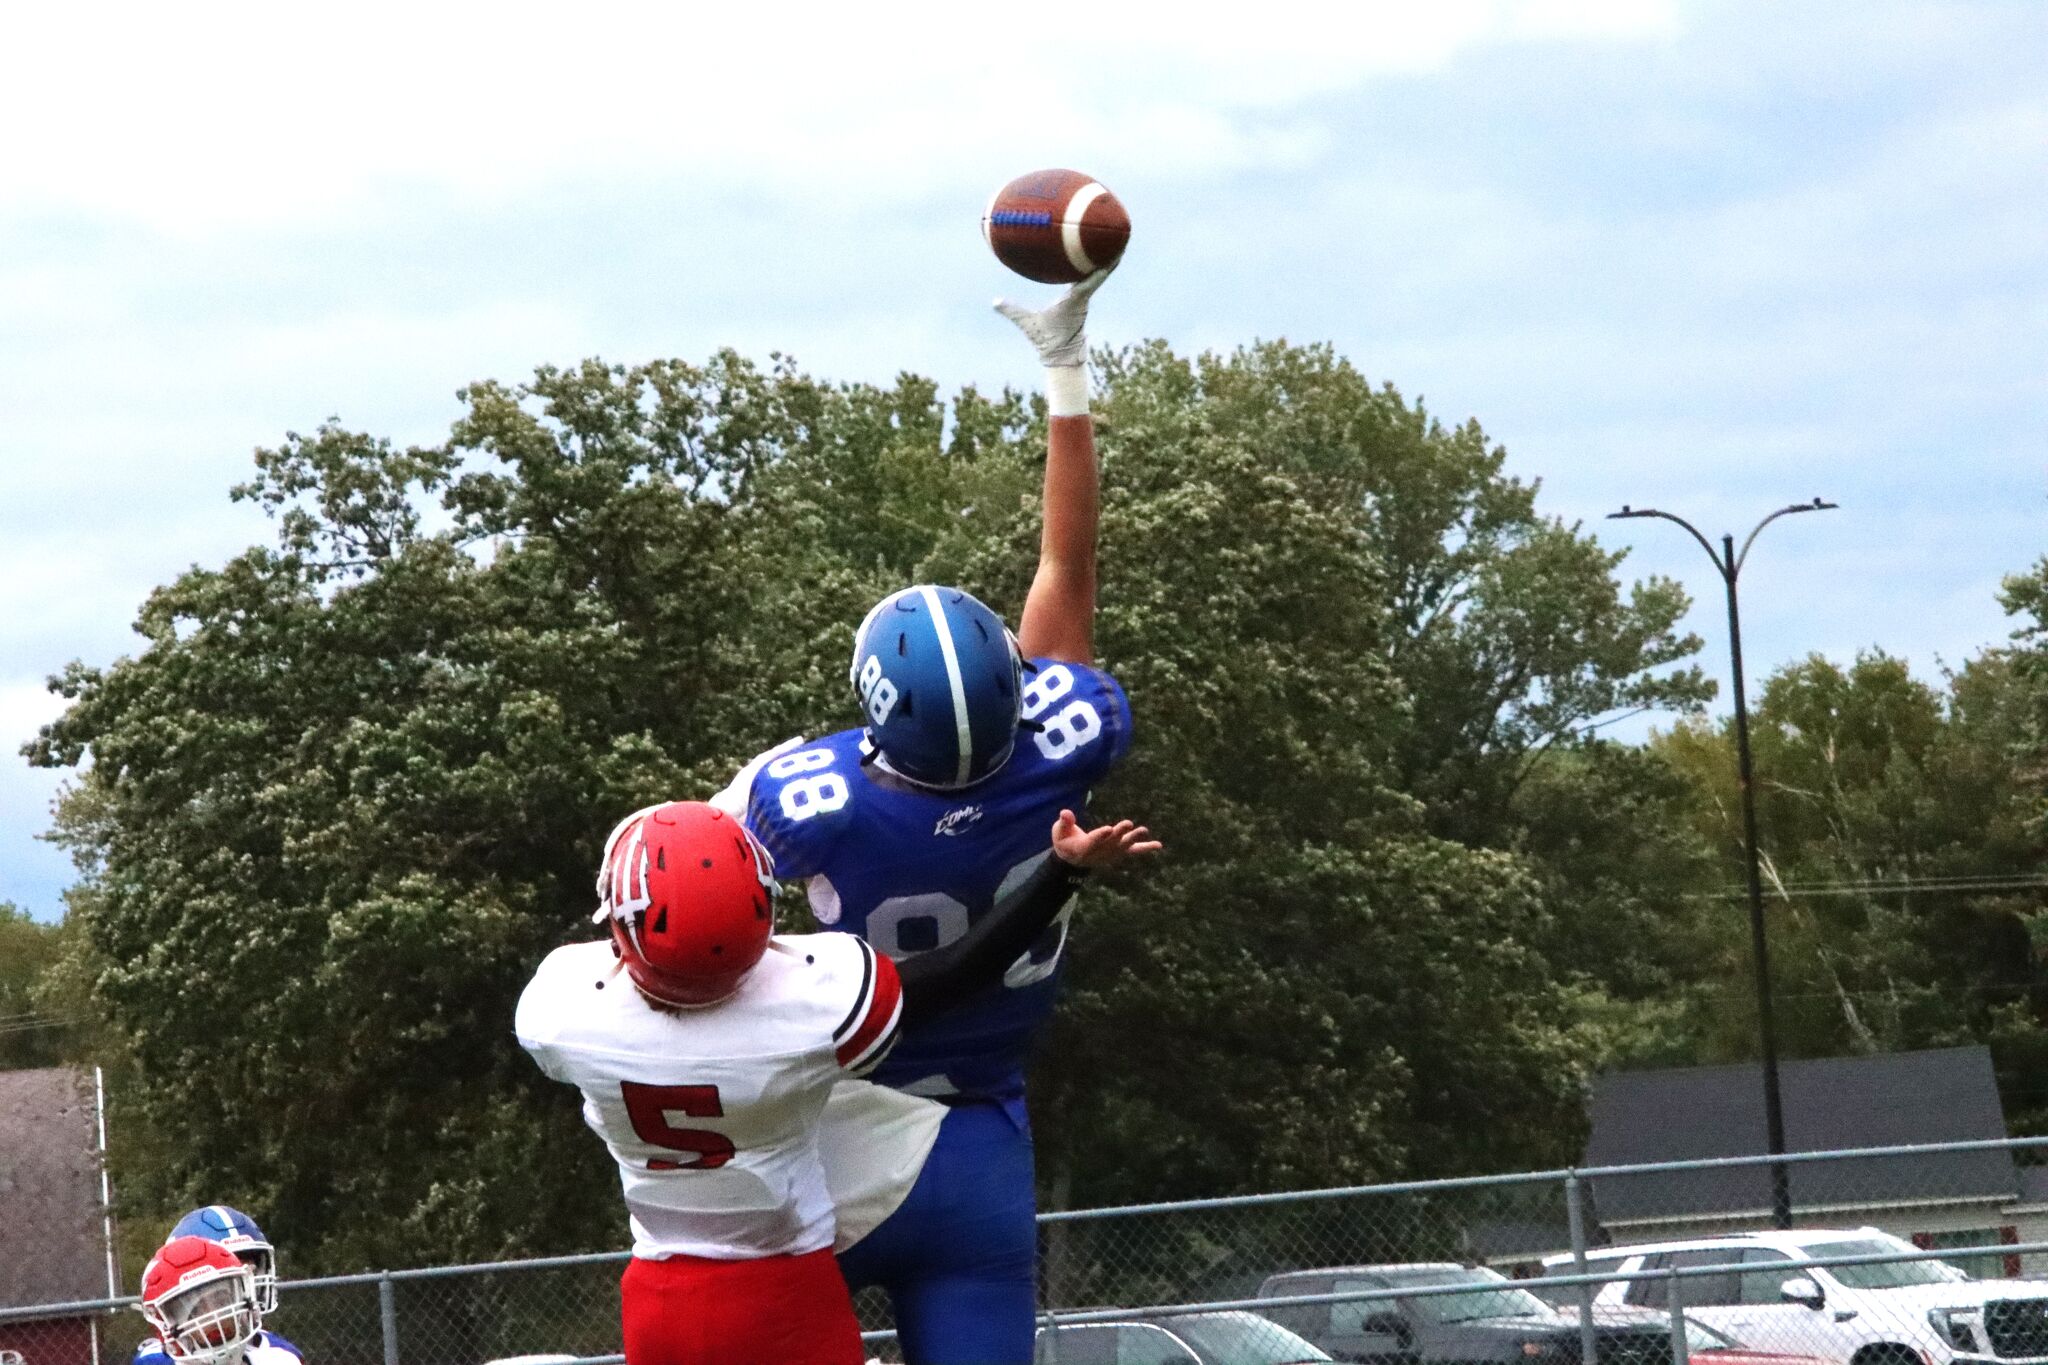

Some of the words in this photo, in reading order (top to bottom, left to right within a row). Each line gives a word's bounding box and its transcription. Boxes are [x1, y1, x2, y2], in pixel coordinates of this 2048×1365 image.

[860, 654, 898, 726] 88
[1022, 664, 1102, 760] 88
[767, 748, 849, 821] 88
[620, 1080, 736, 1170] 5
[183, 1266, 211, 1281] Riddell
